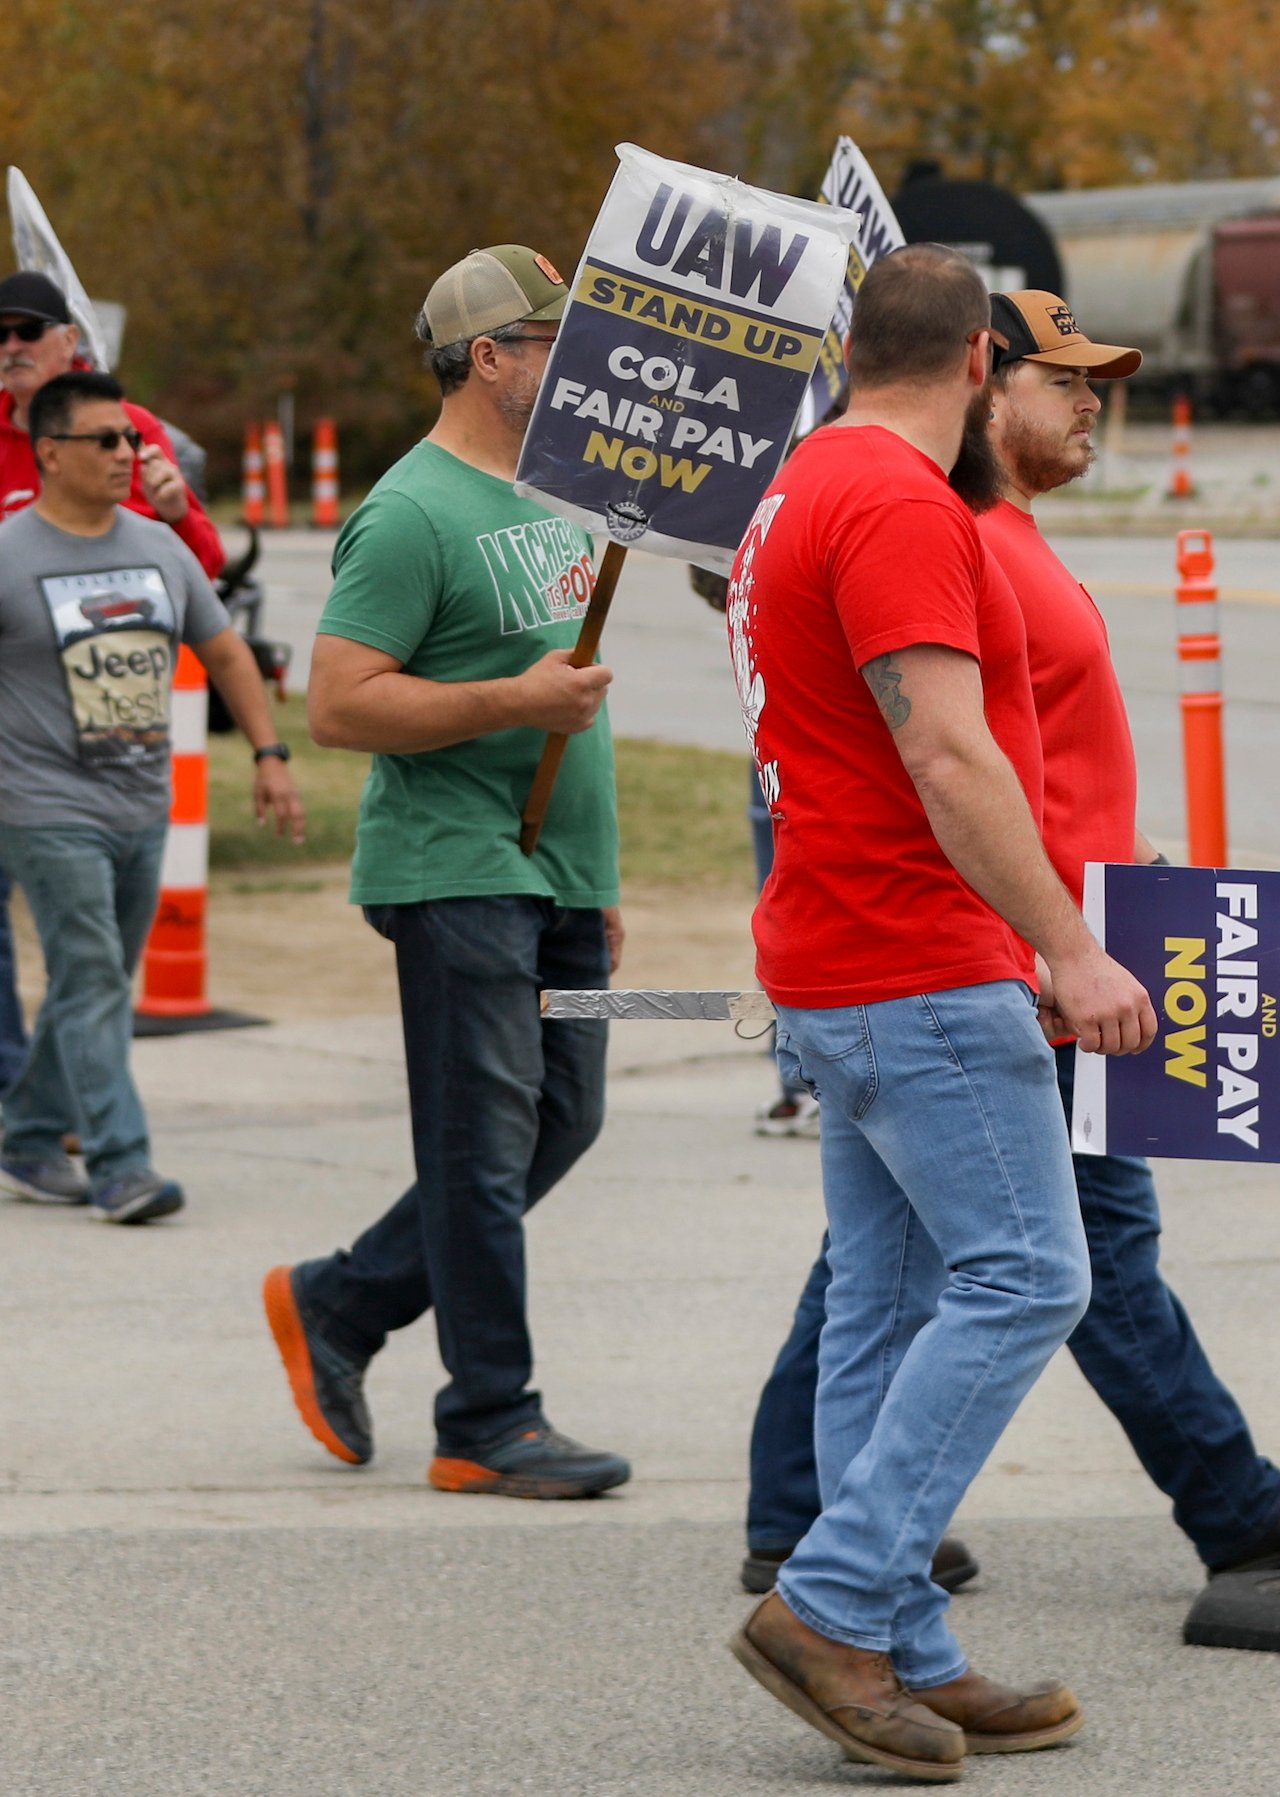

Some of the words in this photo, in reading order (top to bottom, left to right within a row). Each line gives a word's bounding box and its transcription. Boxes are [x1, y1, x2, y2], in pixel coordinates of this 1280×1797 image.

[635, 183, 809, 308] UAW
[589, 278, 731, 341] STAND
[743, 324, 803, 360] UP
[608, 345, 740, 412] COLA
[648, 394, 685, 413] AND
[550, 377, 664, 443] FAIR
[670, 416, 774, 469] PAY
[582, 430, 713, 494] NOW
[74, 643, 168, 681] Jeep
[1215, 882, 1259, 1019] FAIR
[1163, 936, 1208, 1089] NOW
[1261, 993, 1278, 1038] AND
[1216, 1032, 1260, 1150] PAY
